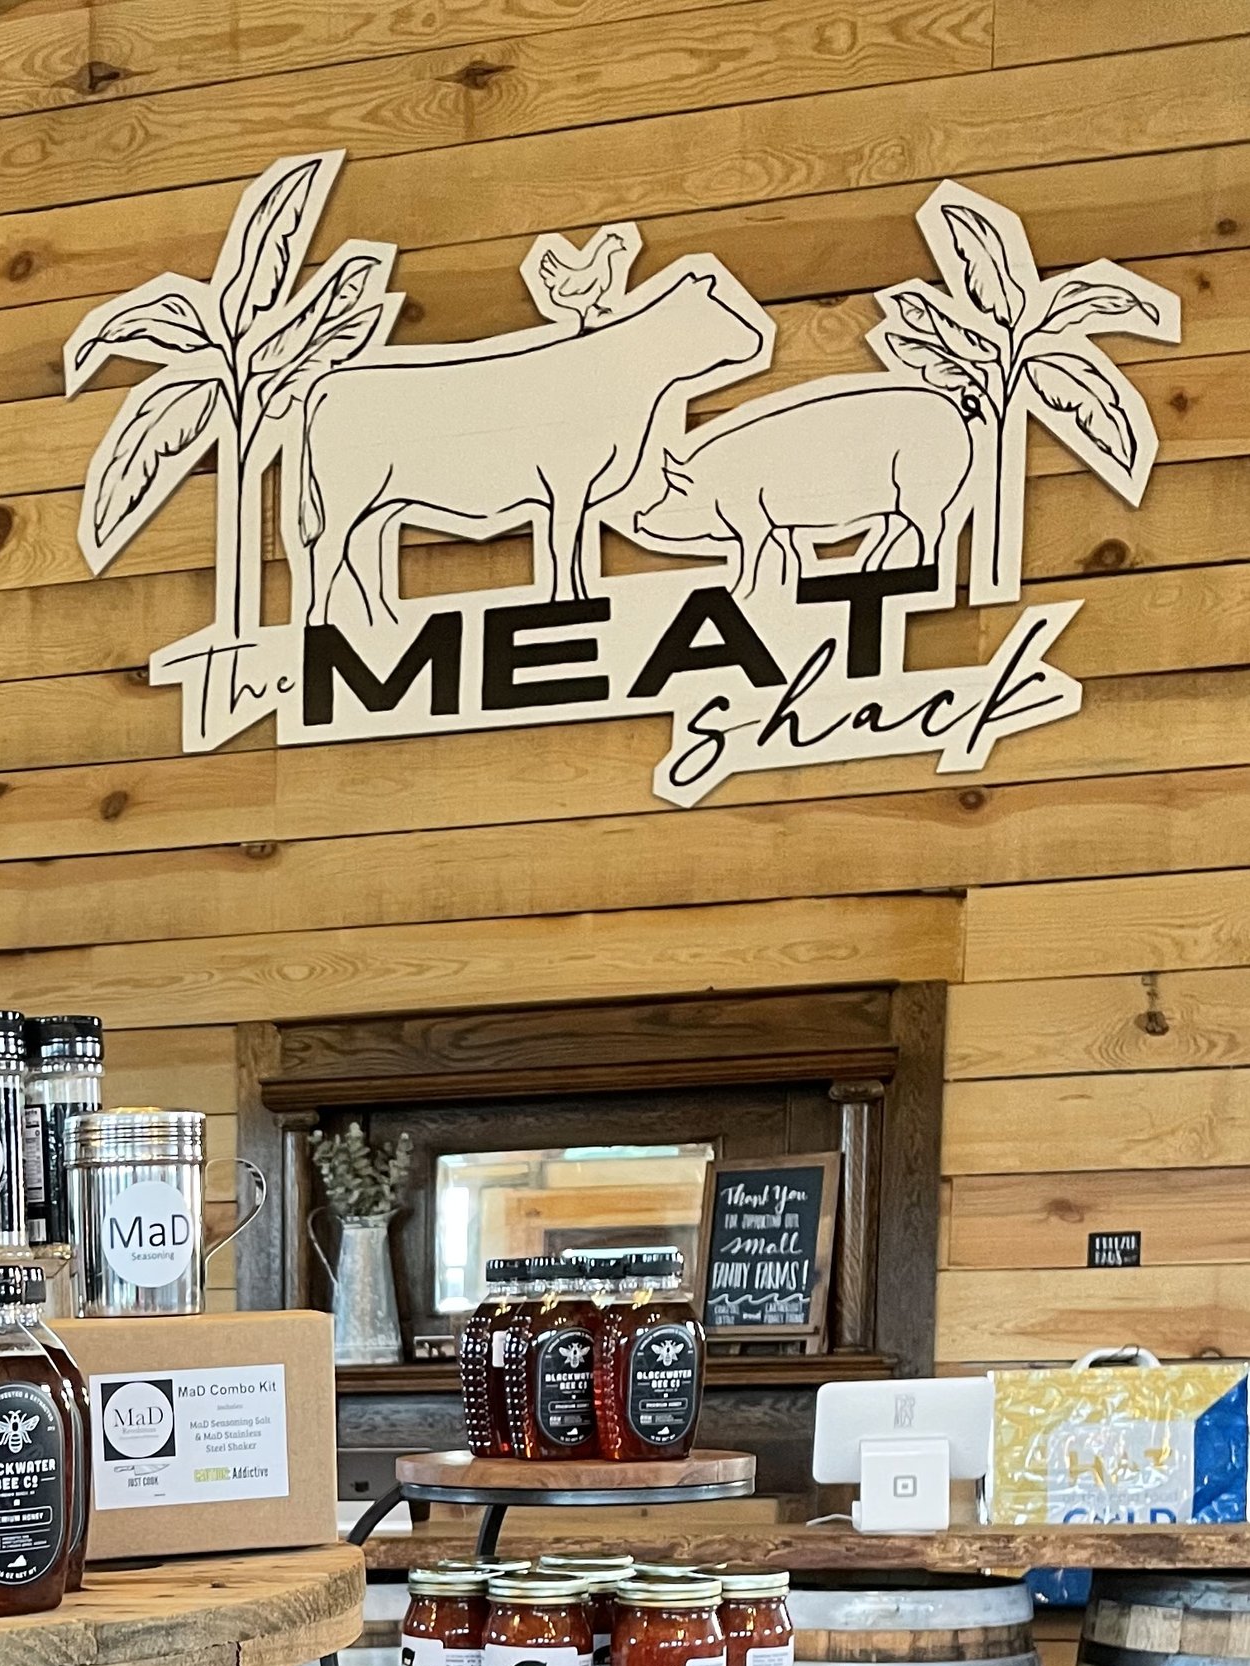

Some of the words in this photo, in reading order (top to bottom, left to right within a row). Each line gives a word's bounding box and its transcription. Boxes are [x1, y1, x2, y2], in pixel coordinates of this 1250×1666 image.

[303, 564, 940, 726] MEAT
[161, 644, 296, 739] The
[669, 618, 1065, 787] shack
[773, 1185, 808, 1214] You
[110, 1214, 190, 1249] MaD
[131, 1250, 175, 1261] Seasoning
[178, 1385, 206, 1398] MaD
[210, 1383, 255, 1396] Combo
[259, 1380, 276, 1393] Kit
[114, 1406, 164, 1428] MaD
[190, 1421, 209, 1429] MaD
[211, 1419, 253, 1427] Seasoning
[203, 1432, 222, 1440] MaD
[225, 1430, 261, 1439] Stainless
[206, 1443, 225, 1453] Steel
[228, 1442, 256, 1451] Shaker
[232, 1465, 268, 1479] Addictive
[22, 1512, 44, 1522] HONEY
